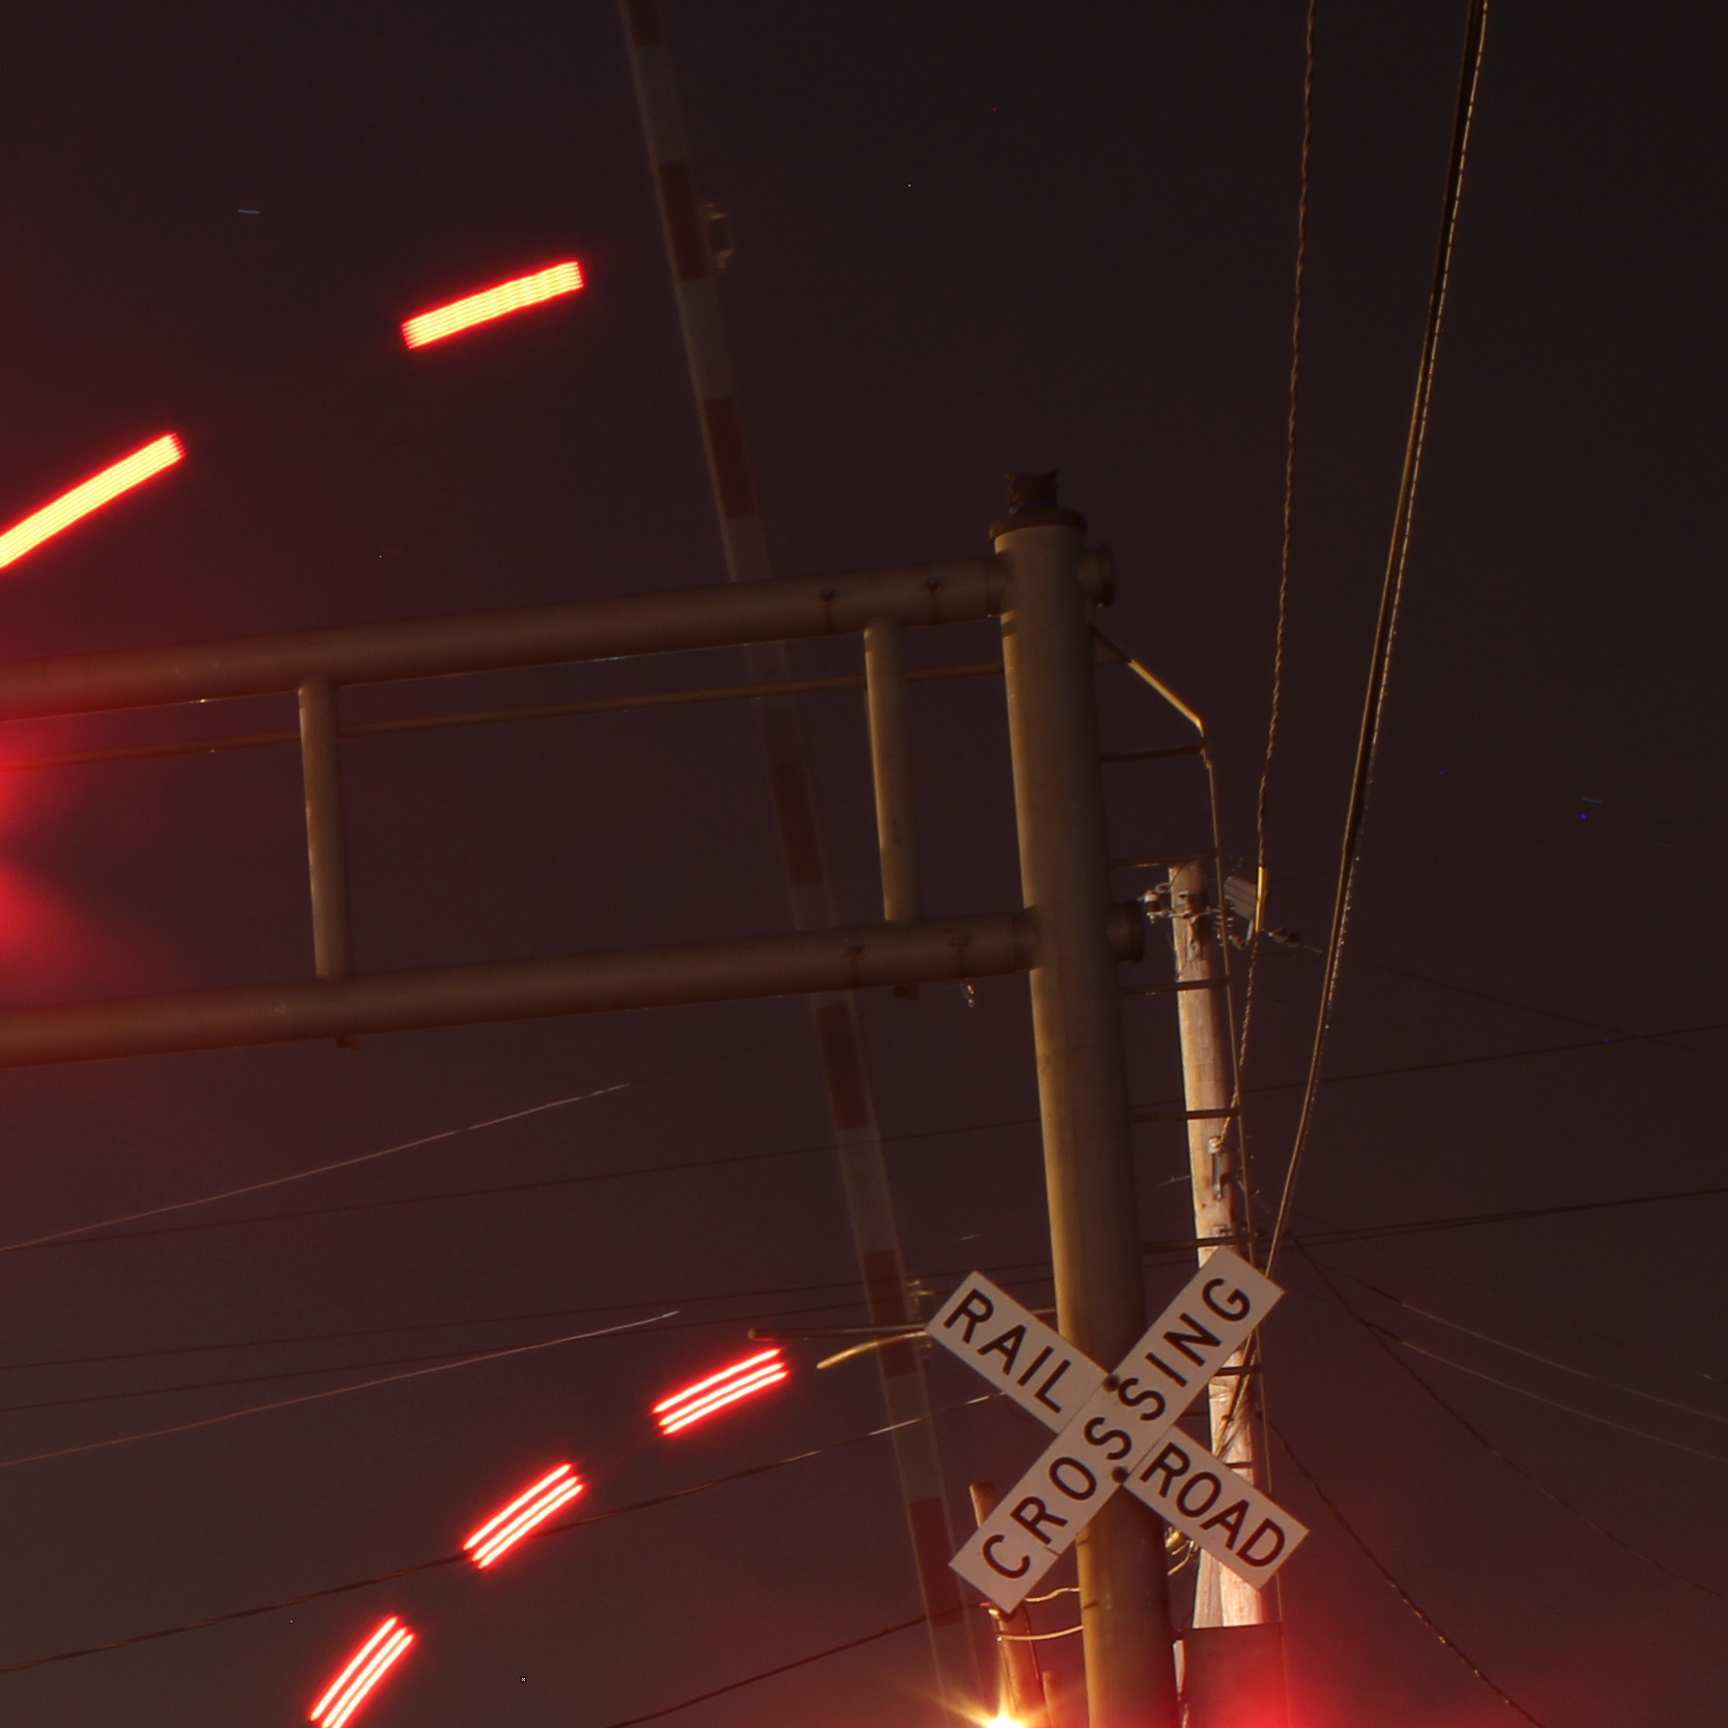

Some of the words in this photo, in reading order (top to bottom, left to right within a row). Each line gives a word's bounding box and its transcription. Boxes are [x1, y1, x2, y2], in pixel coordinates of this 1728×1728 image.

[944, 1287, 1071, 1414] RAIL
[1139, 1441, 1286, 1569] ROAD
[981, 1277, 1252, 1580] CROSSING
